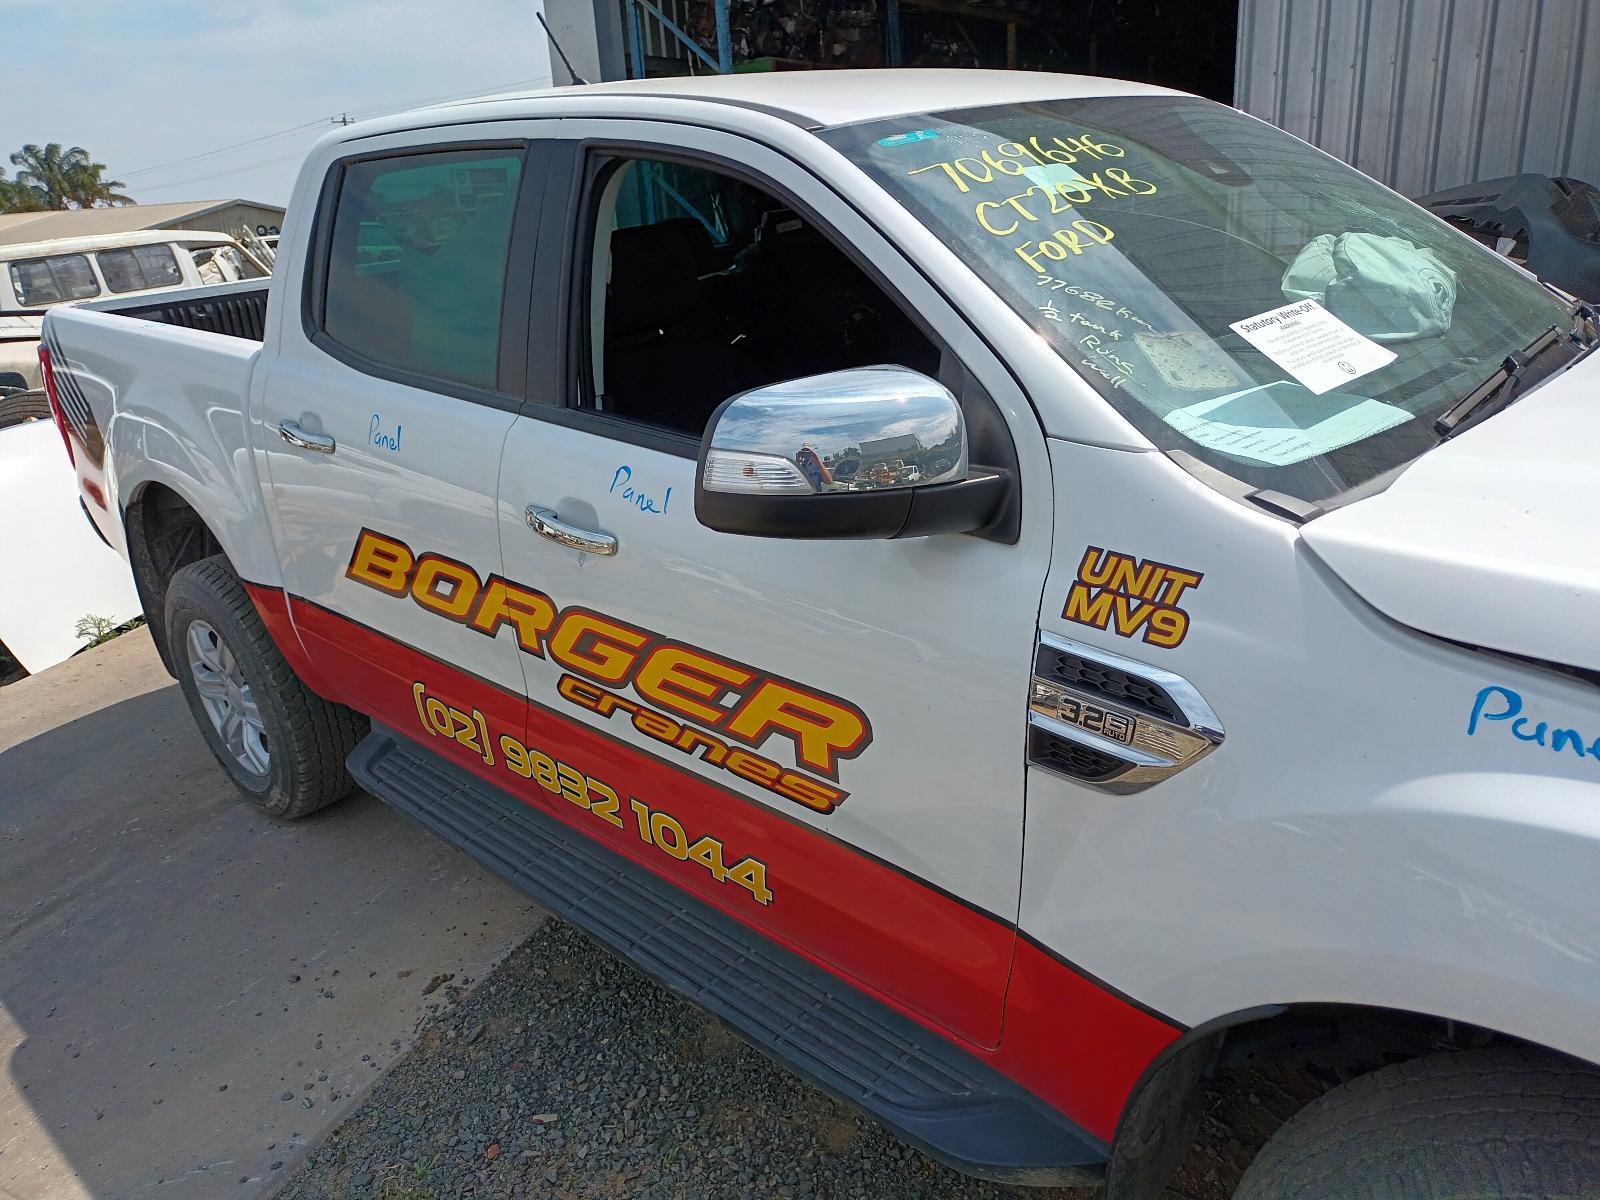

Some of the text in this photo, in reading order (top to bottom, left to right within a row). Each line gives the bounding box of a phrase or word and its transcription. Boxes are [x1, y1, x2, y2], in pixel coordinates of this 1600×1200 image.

[908, 134, 1125, 193] 7069646
[1014, 219, 1116, 273] FORD
[1239, 302, 1317, 334] Statutory Write-Off
[367, 413, 402, 452] Panel
[608, 464, 673, 515] Panel
[1076, 545, 1205, 608] UNIT
[1060, 579, 1191, 650] MV9
[345, 526, 874, 784] BORGER
[1060, 697, 1104, 732] 3.2
[1103, 728, 1126, 741] AUTO
[555, 672, 852, 816] cranes
[411, 681, 775, 907] (02) 9832 1044
